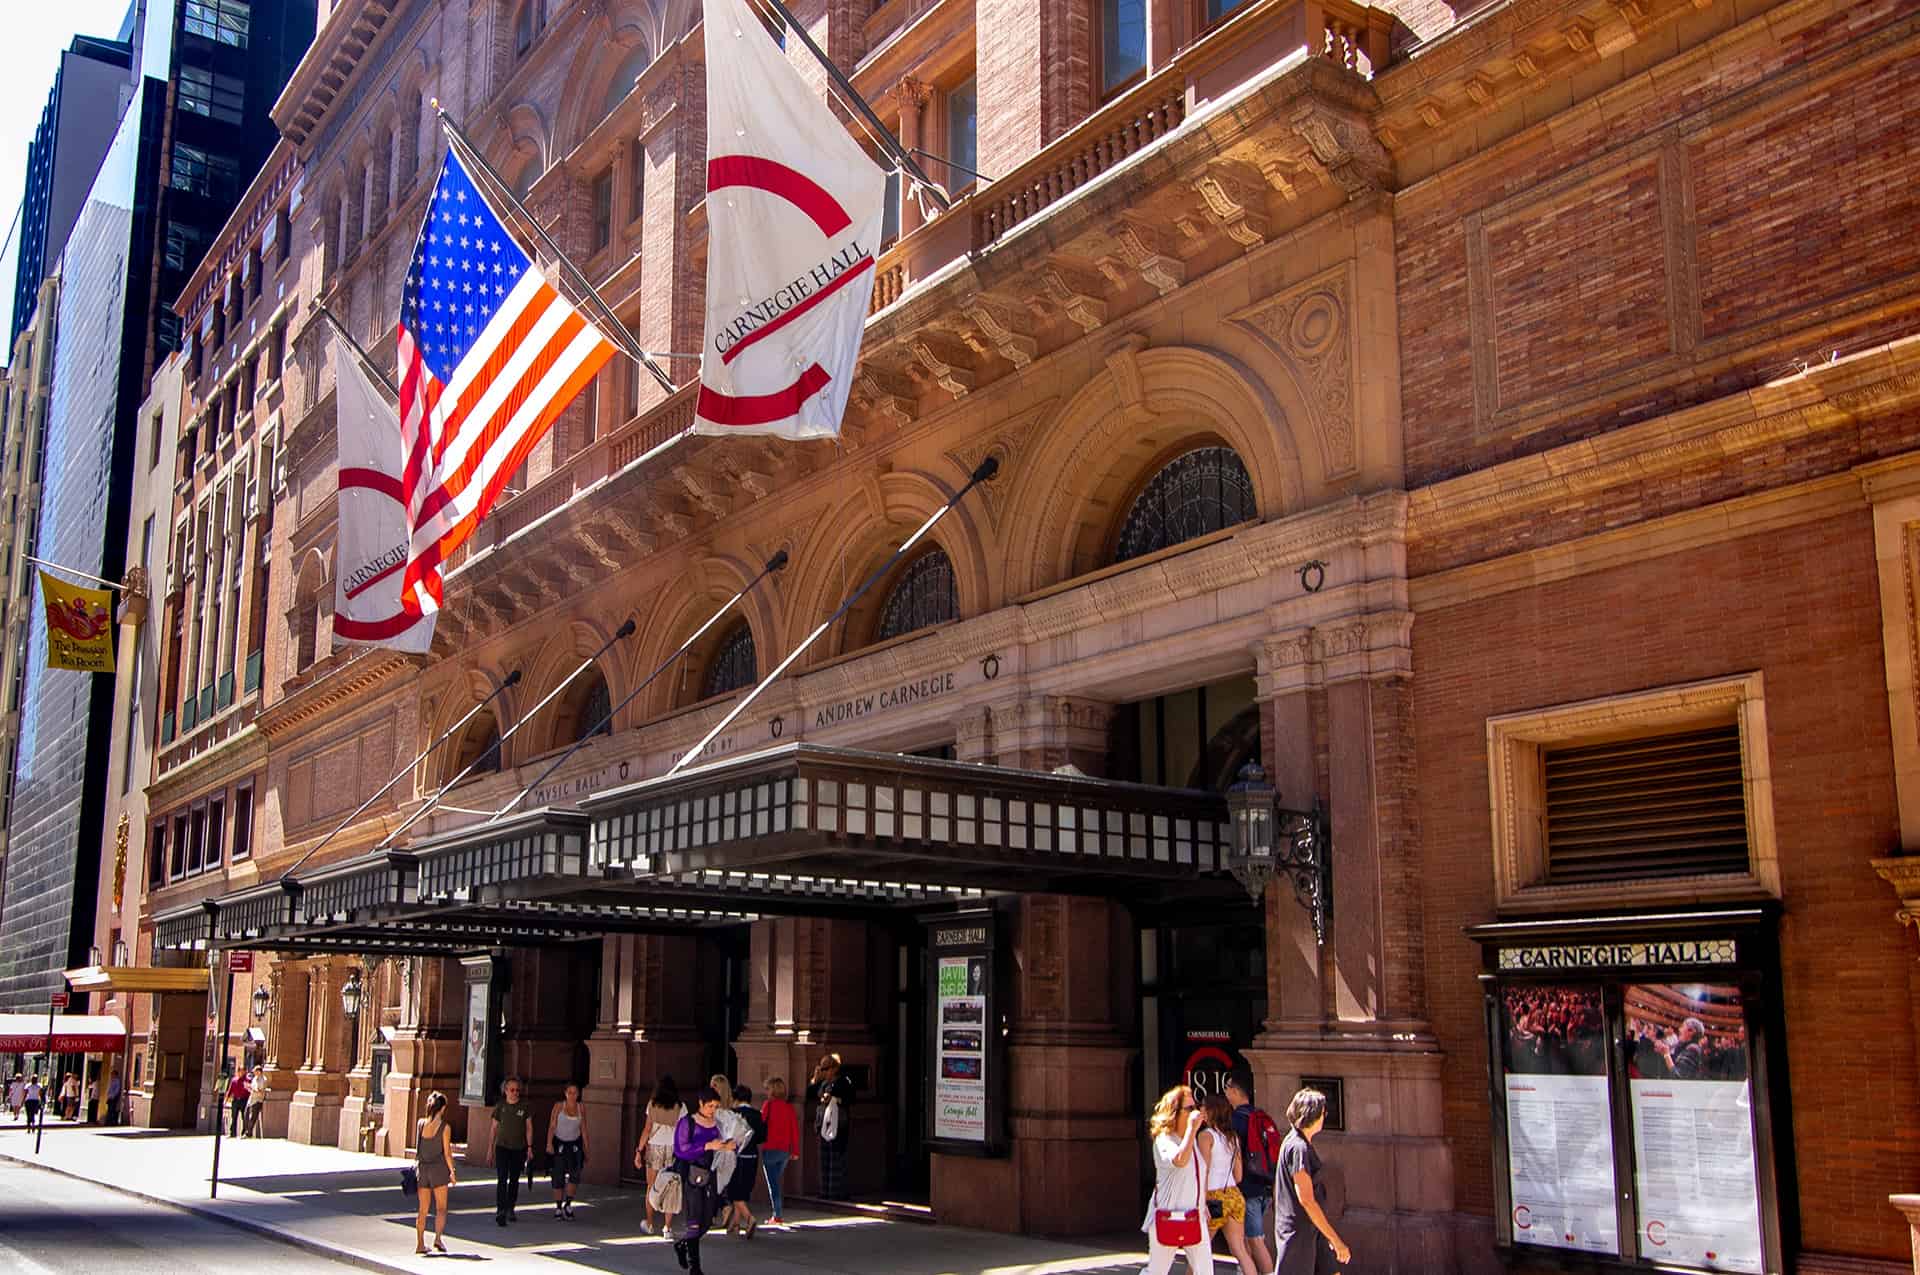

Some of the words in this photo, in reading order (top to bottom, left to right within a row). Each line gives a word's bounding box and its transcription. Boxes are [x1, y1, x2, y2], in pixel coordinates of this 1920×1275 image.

[714, 277, 812, 353] CARNEGIE
[810, 240, 869, 288] HALL
[342, 544, 406, 593] CARNEGIE
[76, 656, 105, 668] Room
[816, 695, 876, 729] ANDREW
[879, 672, 955, 709] CARNEGIE
[1520, 946, 1632, 967] CARNEGIE
[1647, 942, 1712, 964] HALL
